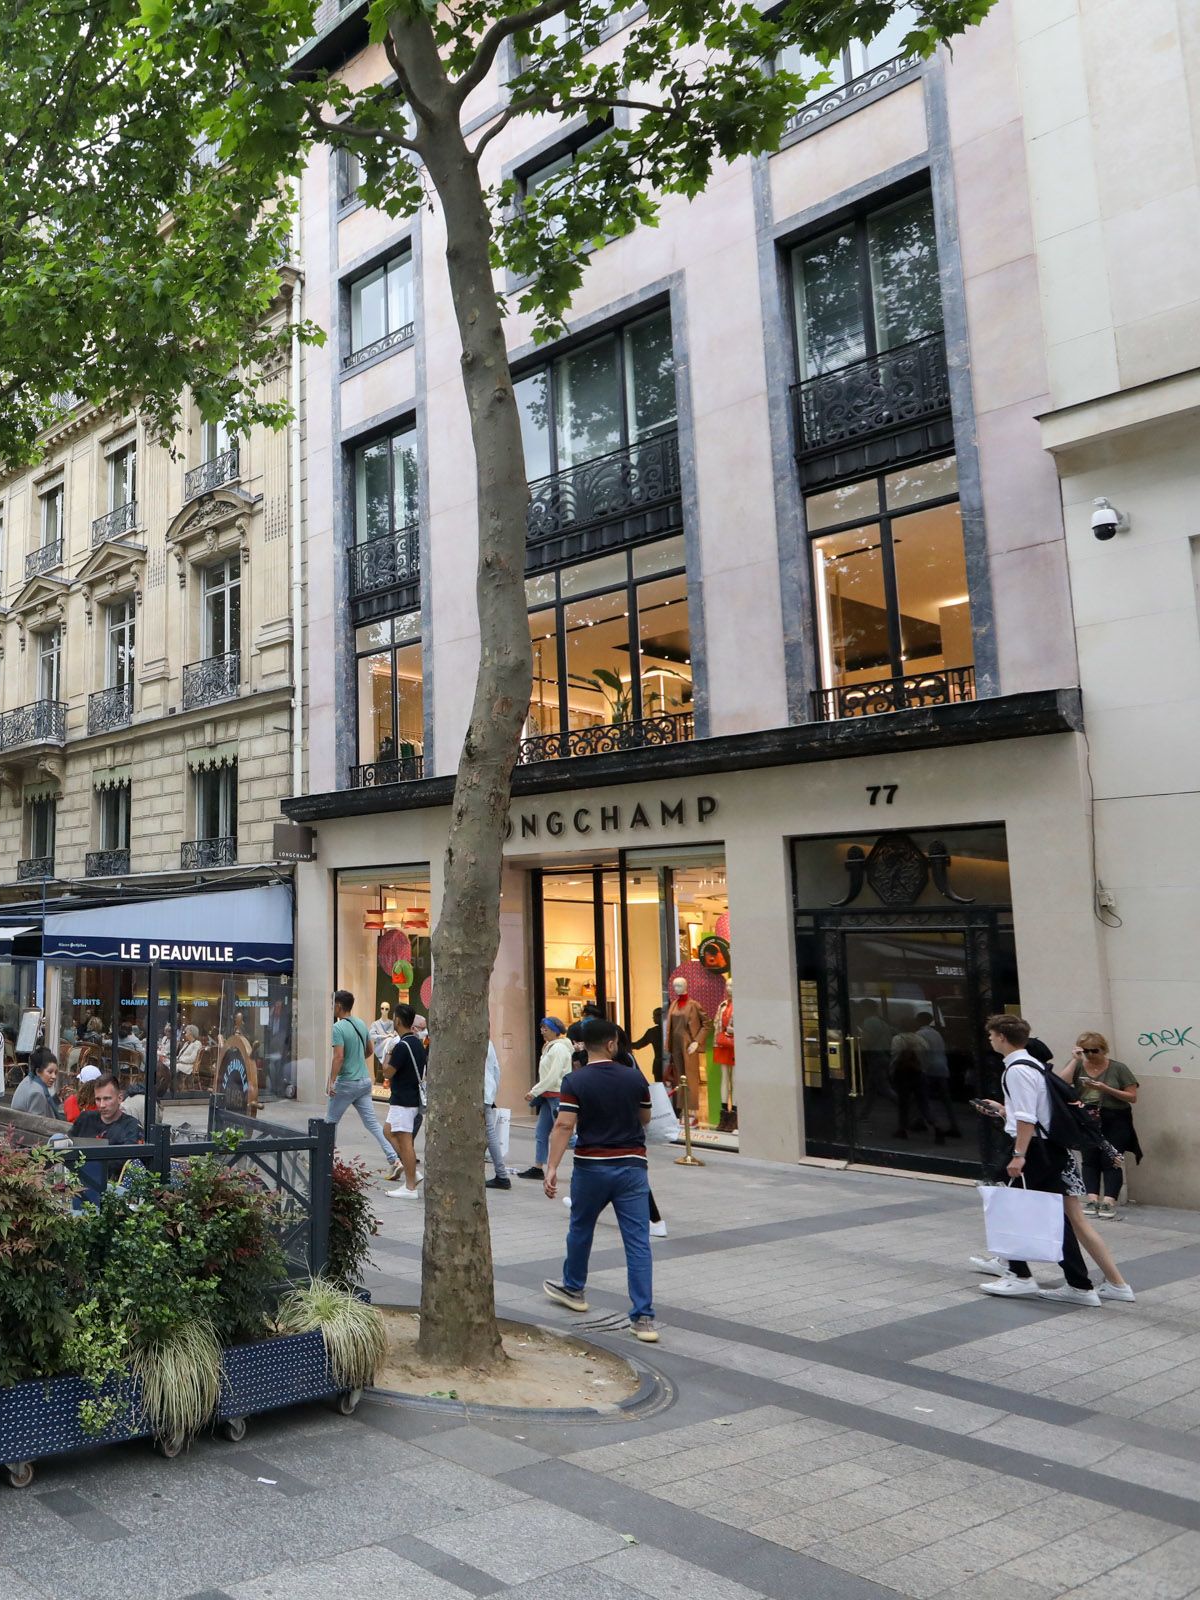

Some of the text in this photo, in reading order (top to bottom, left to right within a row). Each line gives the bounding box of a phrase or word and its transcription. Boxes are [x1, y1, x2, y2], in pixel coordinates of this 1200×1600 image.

[866, 784, 898, 806] 77
[278, 851, 311, 859] LONGCHAMP
[121, 943, 234, 962] LE DEAUVILLE
[72, 998, 101, 1006] SPIRITS
[234, 1000, 269, 1008] COCKTAILS
